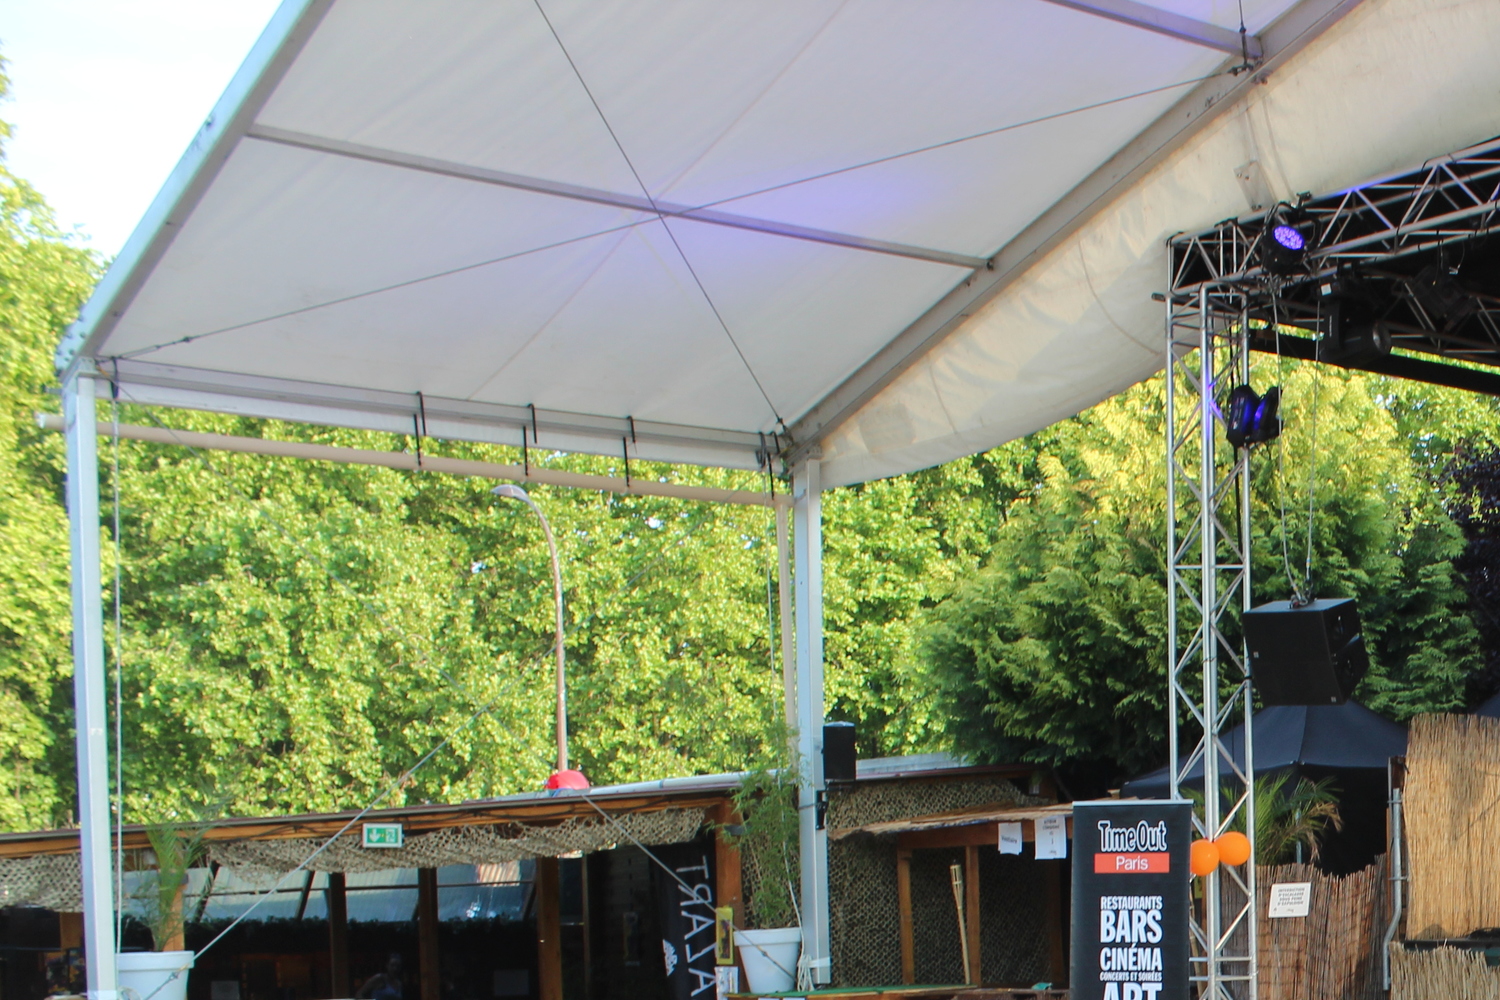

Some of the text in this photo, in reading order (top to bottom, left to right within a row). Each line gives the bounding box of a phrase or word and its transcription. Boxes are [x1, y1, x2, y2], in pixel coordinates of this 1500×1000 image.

[1098, 820, 1136, 852] Time
[1136, 820, 1167, 852] Out
[1116, 855, 1149, 871] Paris
[1100, 895, 1163, 911] RESTAURANTS
[1100, 910, 1163, 943] BARS
[1100, 943, 1163, 971] CINÉMA
[1099, 971, 1129, 981] CONCERTS
[1130, 971, 1138, 981] ET
